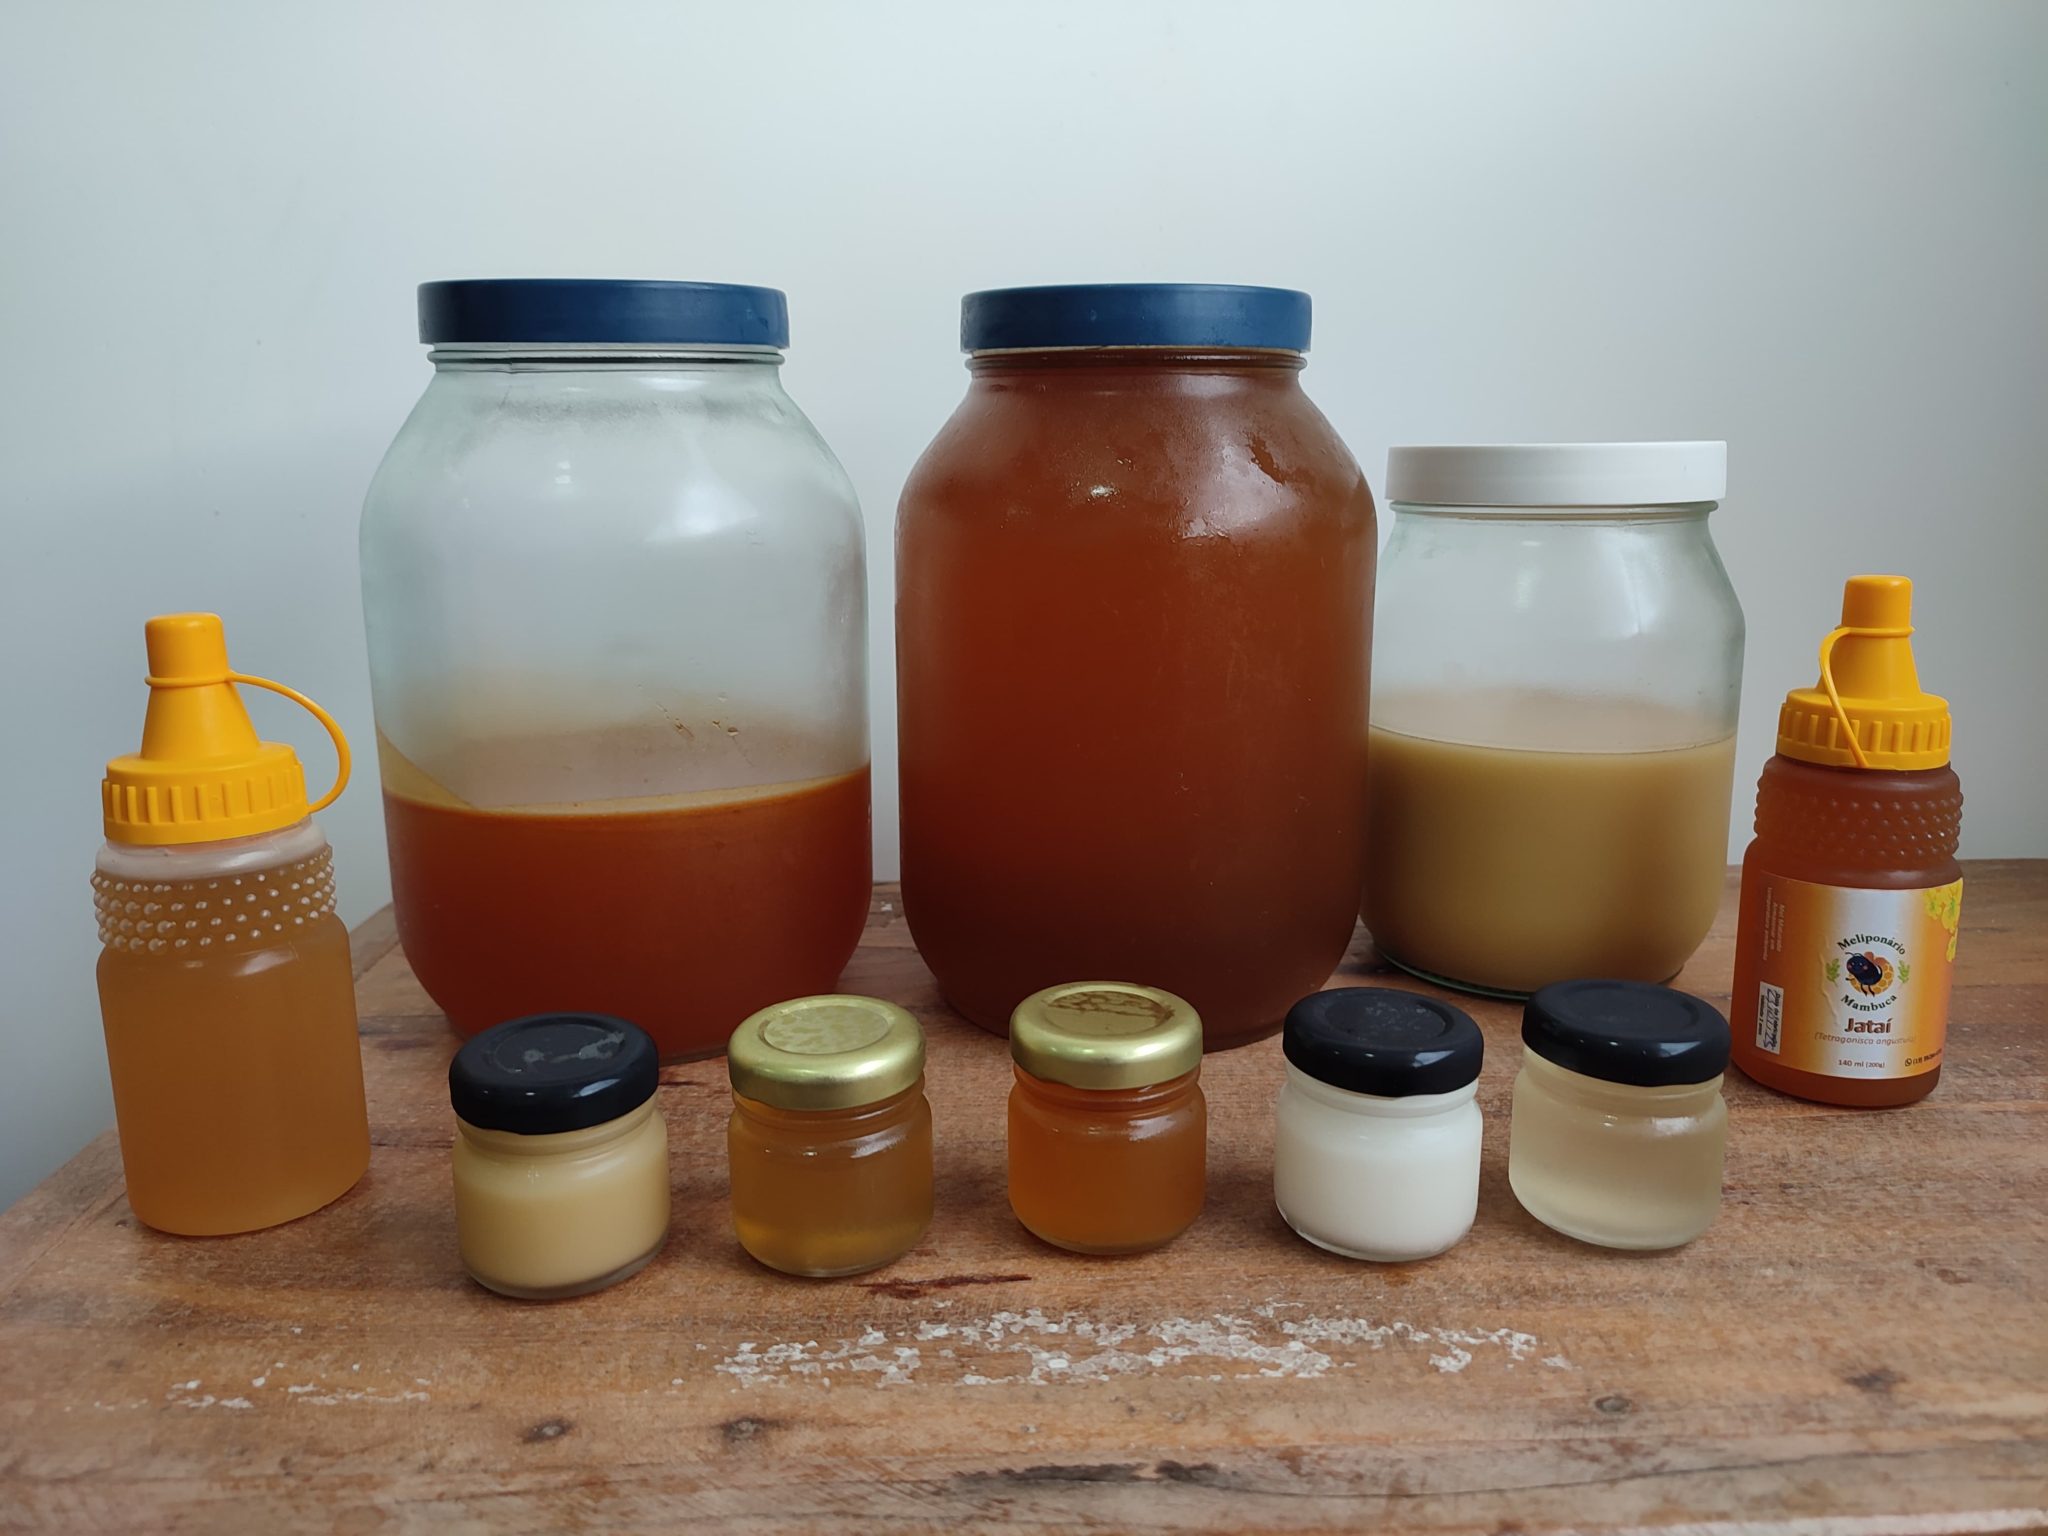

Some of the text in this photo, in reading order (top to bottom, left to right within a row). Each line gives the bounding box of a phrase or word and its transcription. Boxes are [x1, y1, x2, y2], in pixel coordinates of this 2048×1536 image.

[1837, 933, 1906, 955] Meliponário
[1841, 994, 1897, 1012] Mambuca
[1844, 1017, 1893, 1034] Jataí
[1838, 1059, 1853, 1067] 140
[1854, 1060, 1864, 1068] ml
